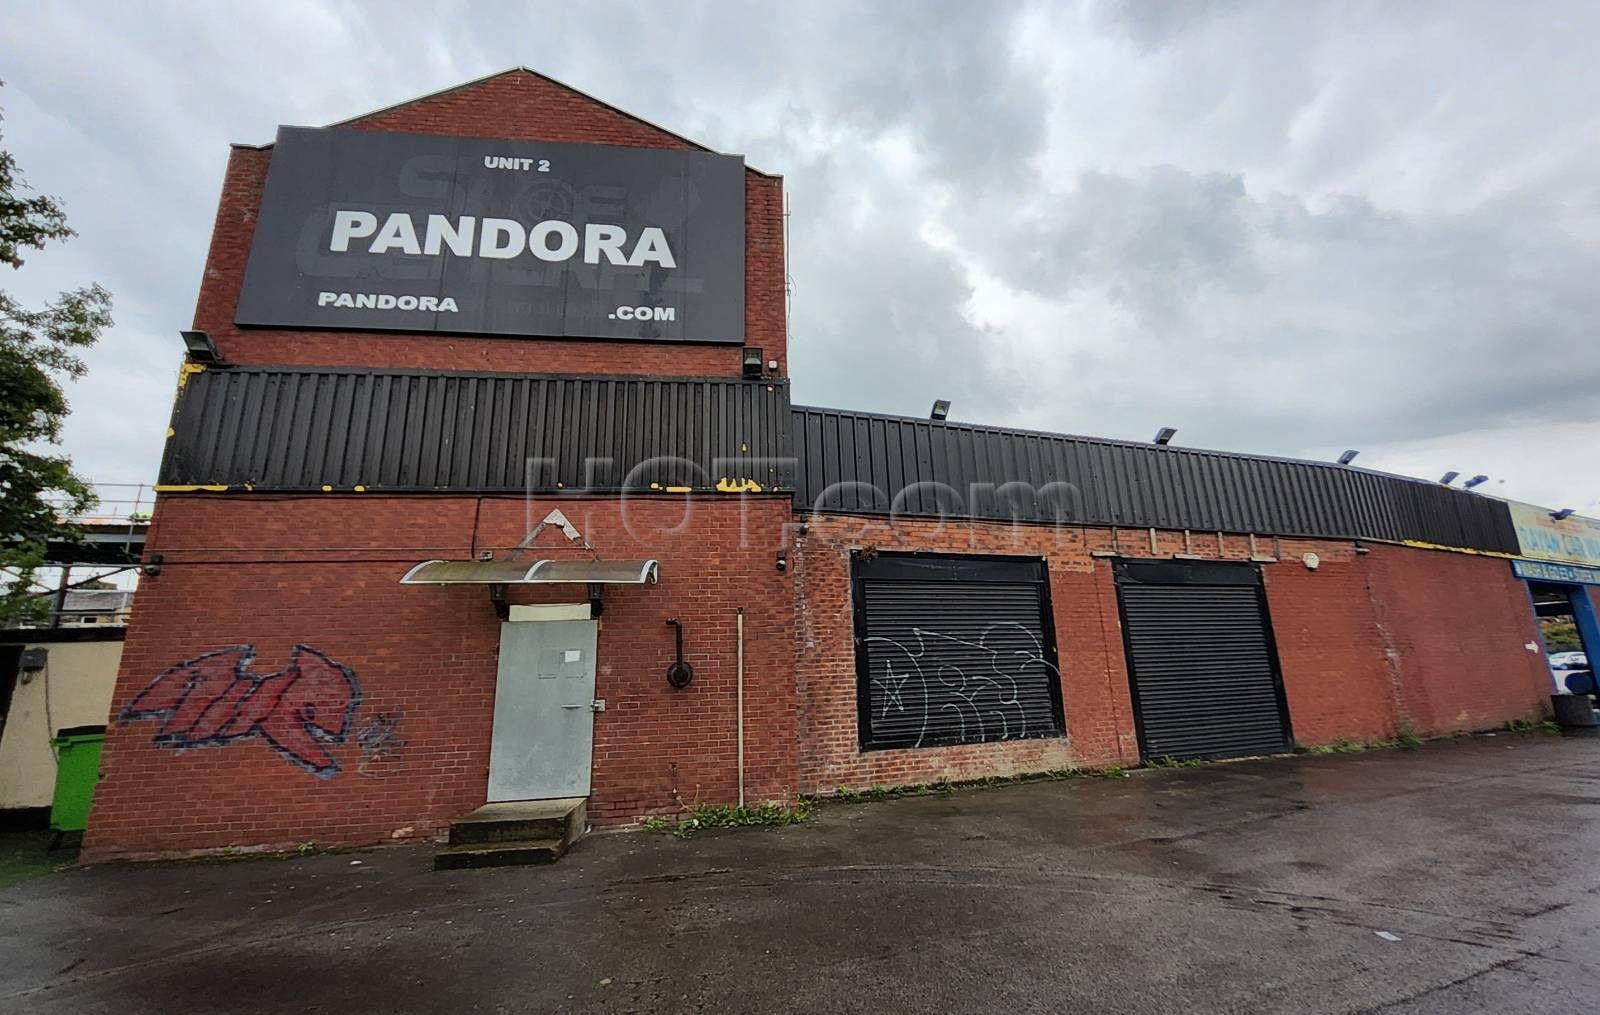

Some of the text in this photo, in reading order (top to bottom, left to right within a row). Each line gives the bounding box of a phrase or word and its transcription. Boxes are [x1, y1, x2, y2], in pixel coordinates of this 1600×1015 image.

[484, 155, 550, 173] UNIT 2
[329, 209, 678, 269] PANDORA
[317, 291, 676, 321] PANDORA .COM
